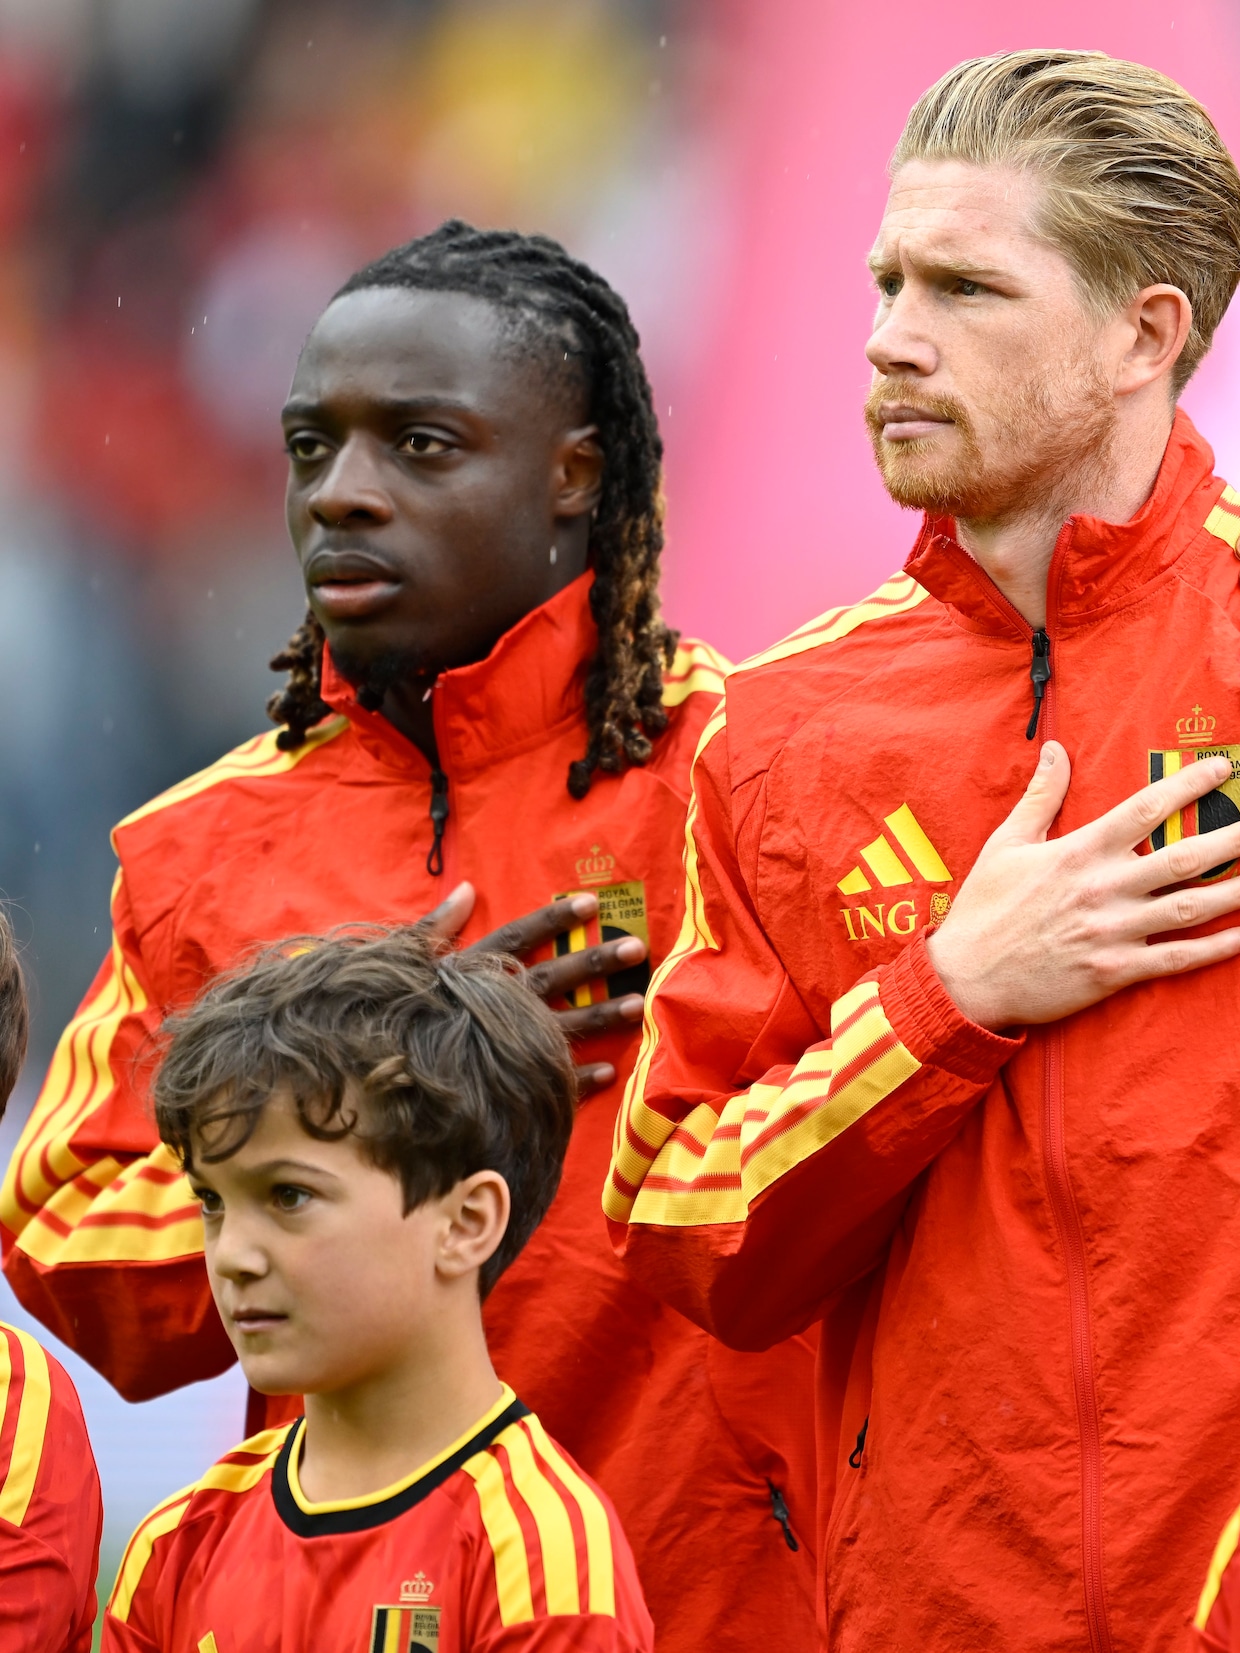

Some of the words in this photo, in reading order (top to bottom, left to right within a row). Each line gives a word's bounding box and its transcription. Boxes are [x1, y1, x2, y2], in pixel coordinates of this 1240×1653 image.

[1197, 750, 1231, 760] ROYAL
[599, 888, 631, 899] ROYAL
[599, 897, 643, 910] BELGIAN
[599, 912, 613, 920] FA
[619, 908, 644, 919] 1895
[839, 899, 918, 941] ING
